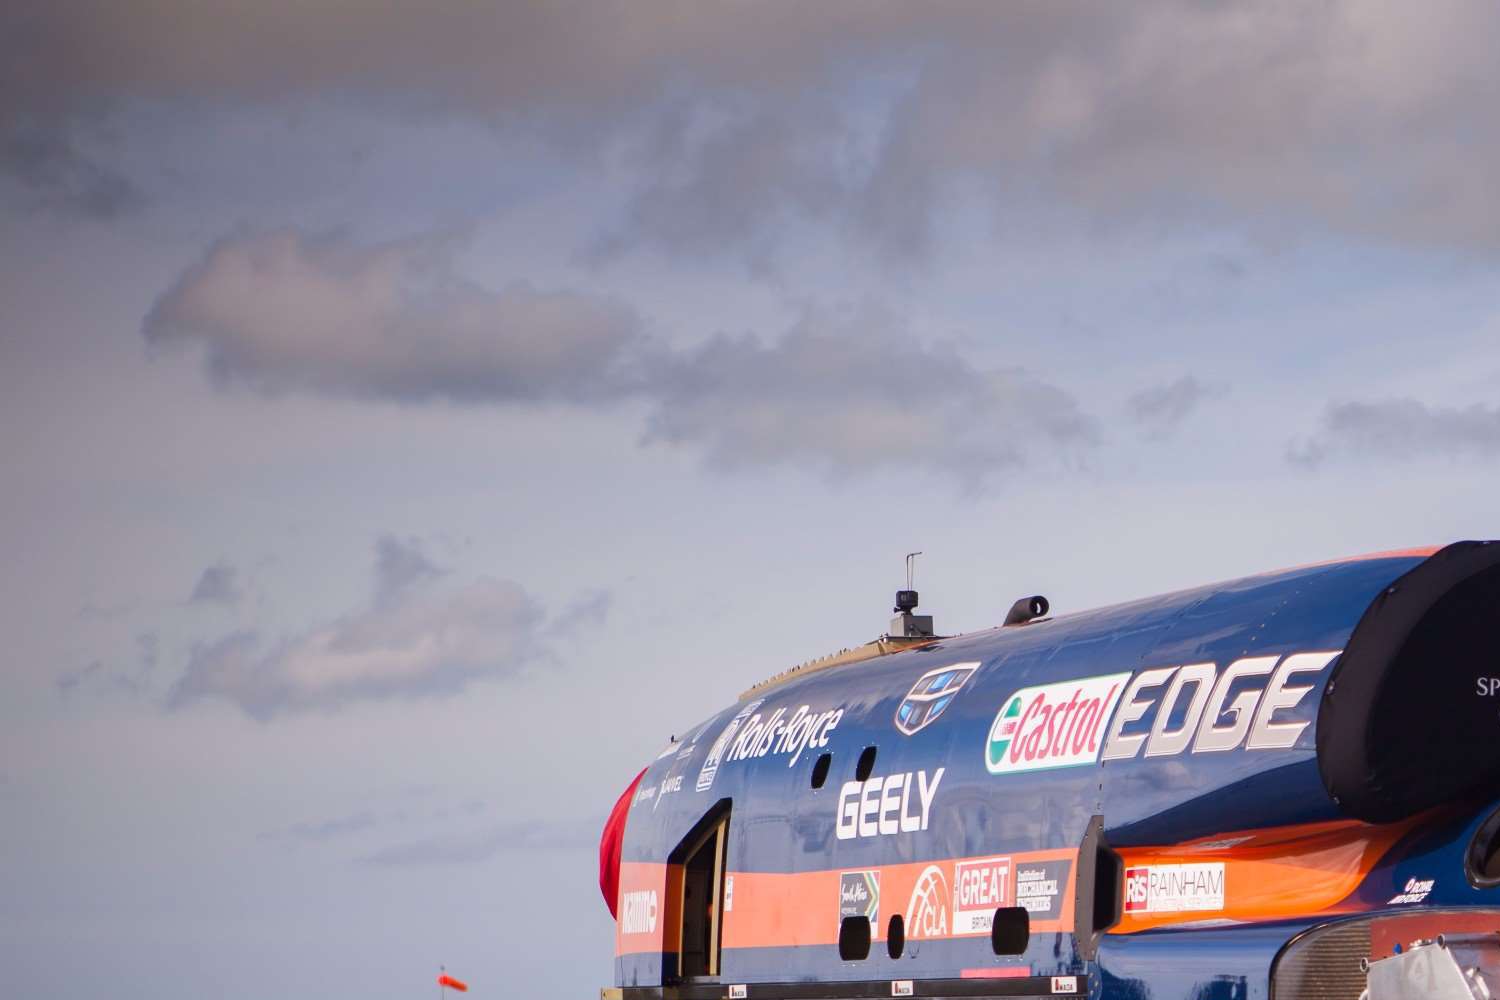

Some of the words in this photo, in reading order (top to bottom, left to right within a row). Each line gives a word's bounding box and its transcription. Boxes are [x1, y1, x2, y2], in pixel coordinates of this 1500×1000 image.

[1010, 683, 1115, 764] Castrol
[1102, 649, 1343, 761] EDGE
[726, 705, 845, 768] Rolls-Royce
[835, 767, 946, 840] GEELY
[960, 866, 1009, 906] GREAT
[1151, 870, 1223, 897] RAINHAM
[923, 903, 948, 937] CLA
